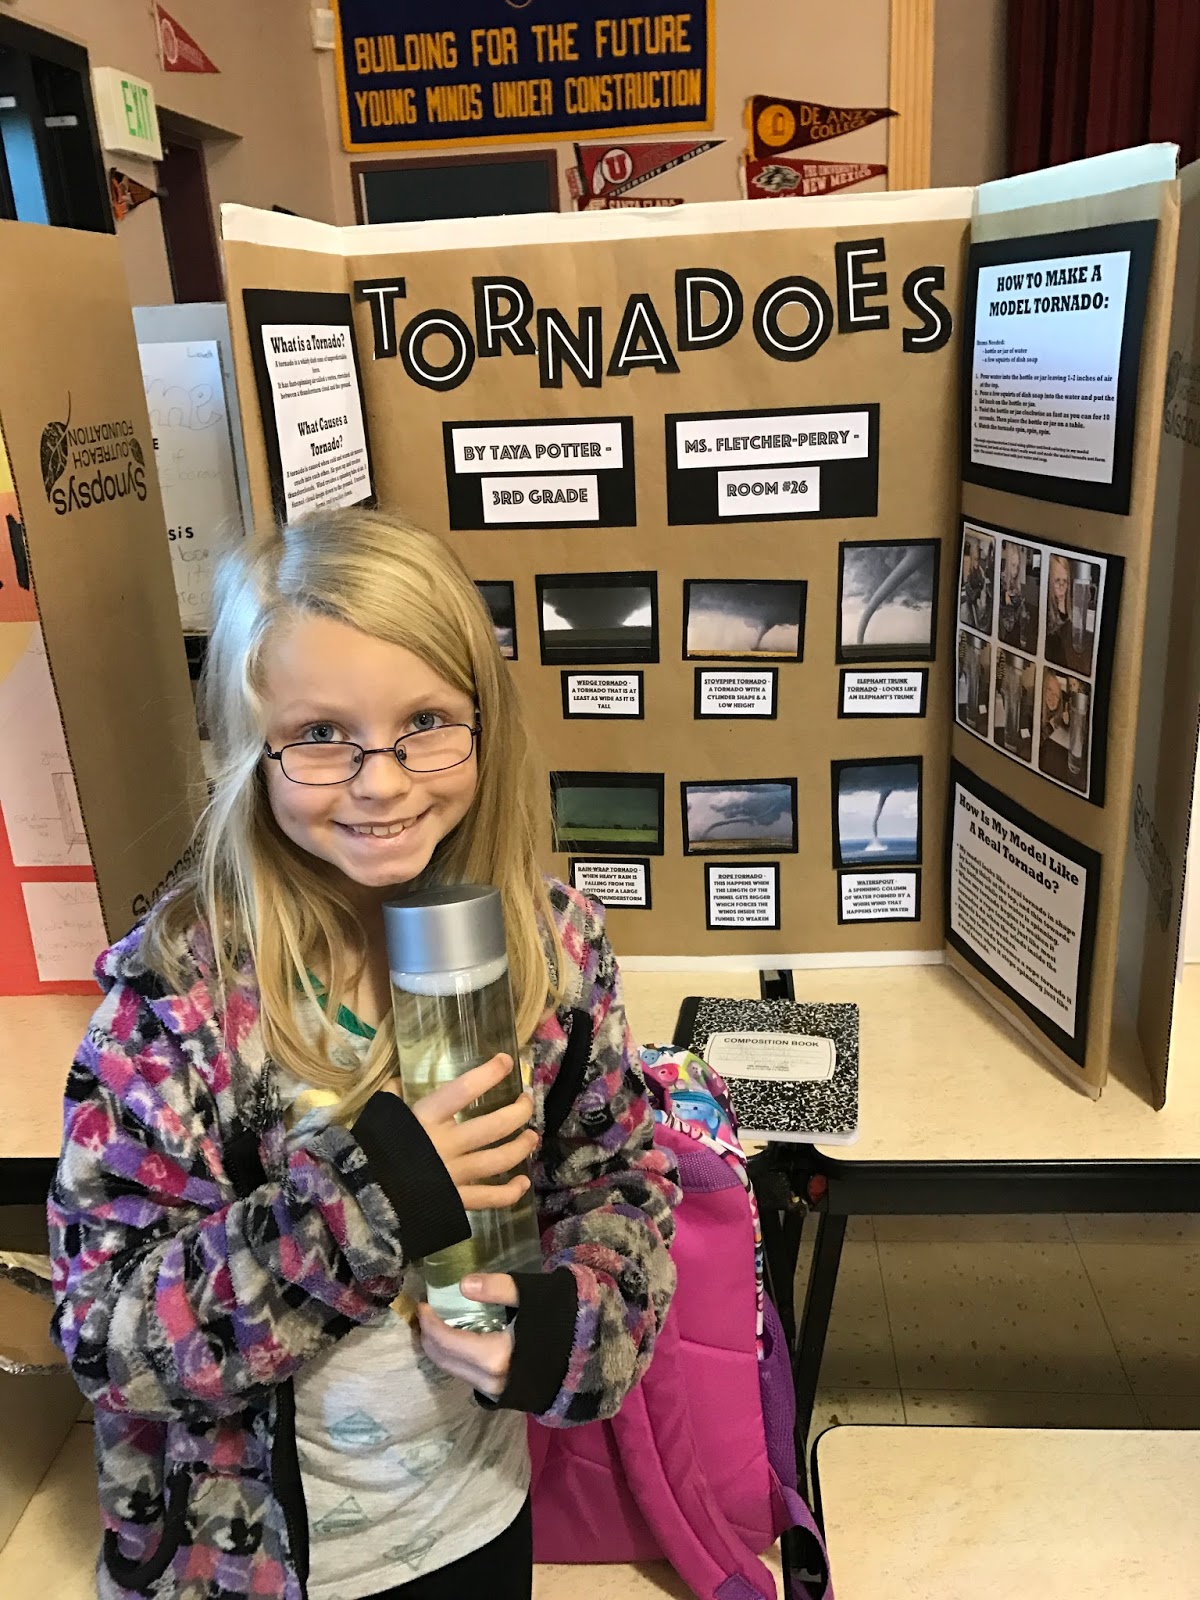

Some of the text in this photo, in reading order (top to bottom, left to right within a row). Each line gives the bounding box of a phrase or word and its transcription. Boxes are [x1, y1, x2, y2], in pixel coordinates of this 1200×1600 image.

[354, 13, 691, 75] BUILDING FOR THE FUTURE
[354, 68, 701, 127] YOUNG MINDS UNDER CONSTRUCTION
[121, 80, 154, 142] EXIT
[800, 105, 821, 126] DE
[605, 153, 627, 181] U
[609, 167, 661, 197] NIVERSITY
[802, 176, 826, 195] NEW
[997, 264, 1102, 292] HOW TO MAKE A
[353, 237, 952, 391] TORNADOES
[989, 292, 1109, 316] MODEL TORNADO:
[270, 333, 345, 354] What is a Tornado?
[67, 420, 133, 446] FOUNDATION
[298, 415, 348, 437] What Causes a
[310, 434, 343, 456] Tornado?
[463, 442, 601, 461] BY TAYA POTTER
[684, 430, 850, 453] MS. FLETCHER-PERRY
[72, 441, 130, 469] OUTREACH
[52, 462, 147, 516] Synopsys
[493, 488, 588, 505] 3RD GRADE
[727, 480, 808, 497] ROOM #26
[959, 792, 1079, 886] How Is My Model Like
[969, 821, 1059, 894] A Real Tornado?
[1023, 895, 1076, 937] tornado shape
[1044, 921, 1070, 943] towards
[1040, 976, 1066, 1000] tornado
[724, 1037, 789, 1046] COMPOSITION
